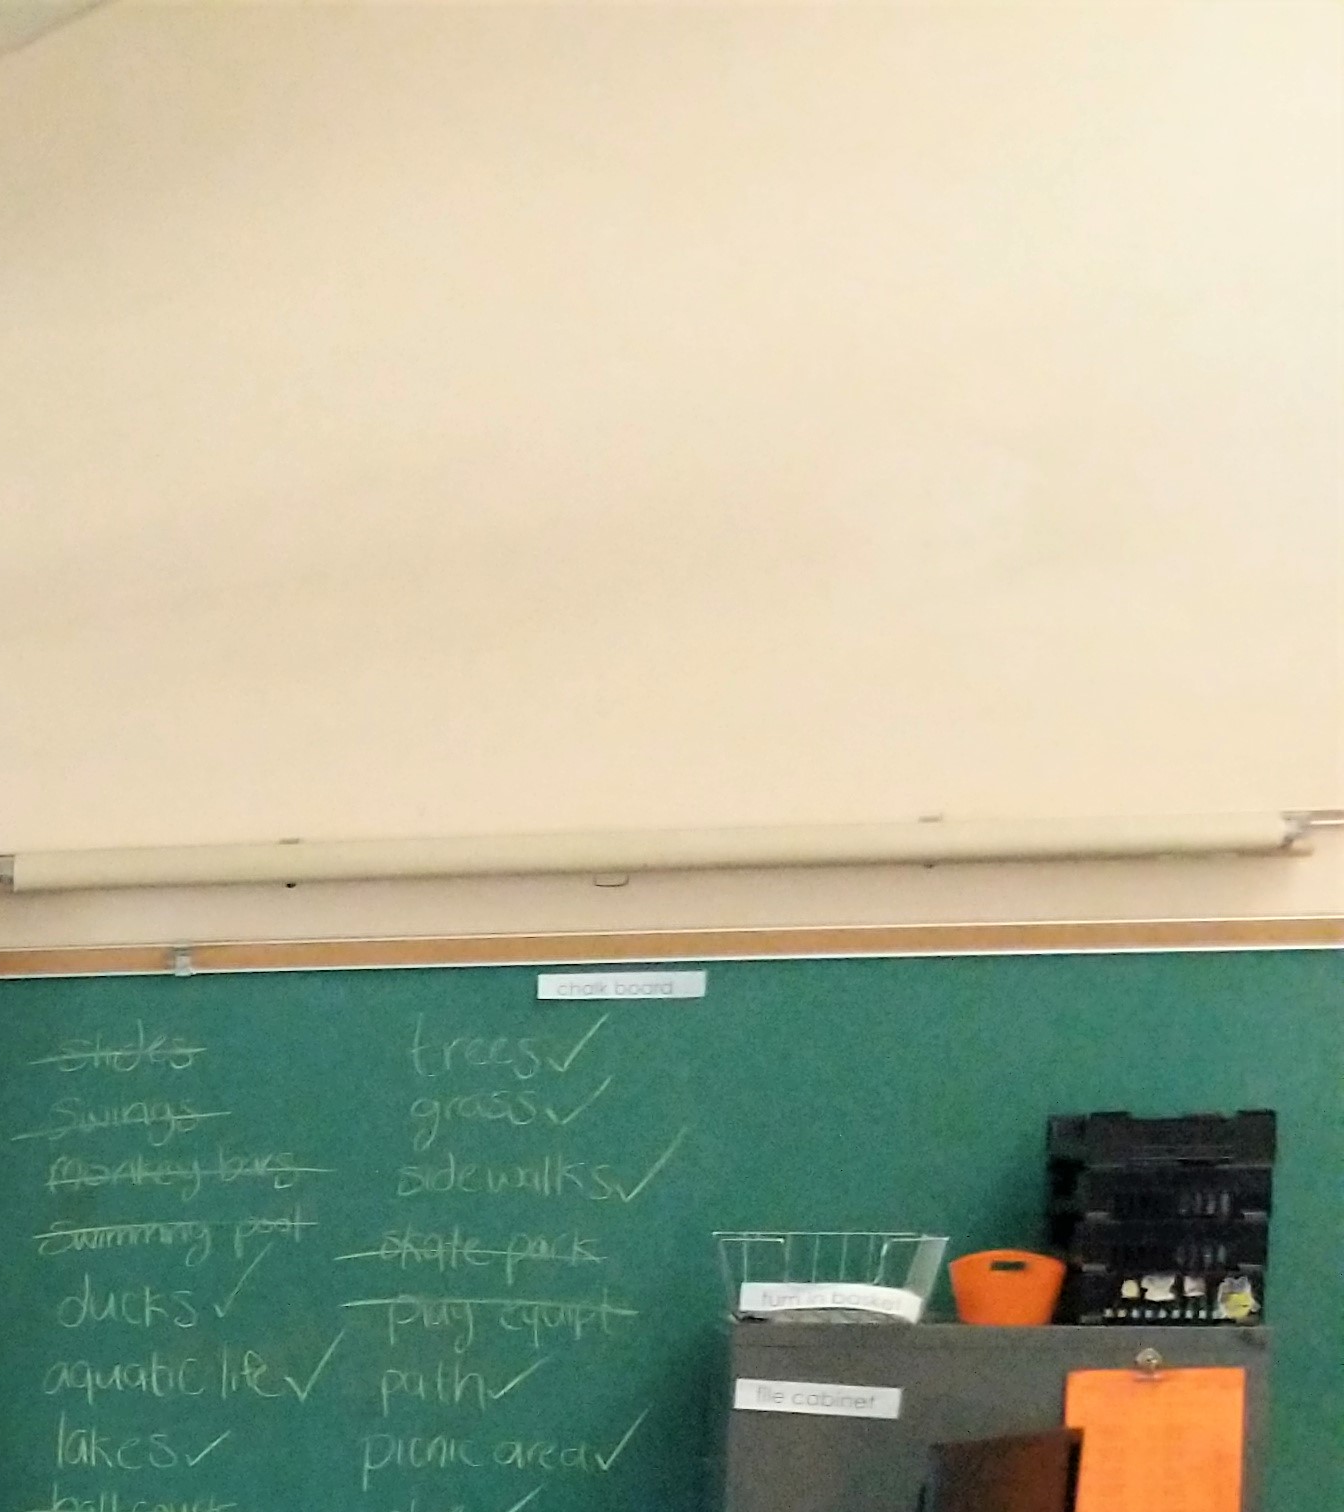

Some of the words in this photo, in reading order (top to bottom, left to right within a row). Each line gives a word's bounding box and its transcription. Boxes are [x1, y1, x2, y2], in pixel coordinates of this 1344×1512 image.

[556, 979, 609, 996] chalk
[614, 979, 674, 996] board
[58, 1018, 195, 1072] slides
[410, 1011, 541, 1081] trees
[411, 1084, 538, 1150] grass
[234, 1202, 304, 1260] pool
[379, 1224, 492, 1270] skate
[505, 1231, 604, 1286] park
[58, 1273, 198, 1329] ducks
[388, 1292, 476, 1354] play
[44, 1352, 205, 1405] aquatic
[221, 1343, 287, 1398] life
[381, 1362, 488, 1416] path
[755, 1386, 784, 1404] file
[791, 1390, 876, 1410] cabinet
[58, 1411, 177, 1469] lakes
[361, 1432, 485, 1492] picnic
[493, 1439, 590, 1471] area
